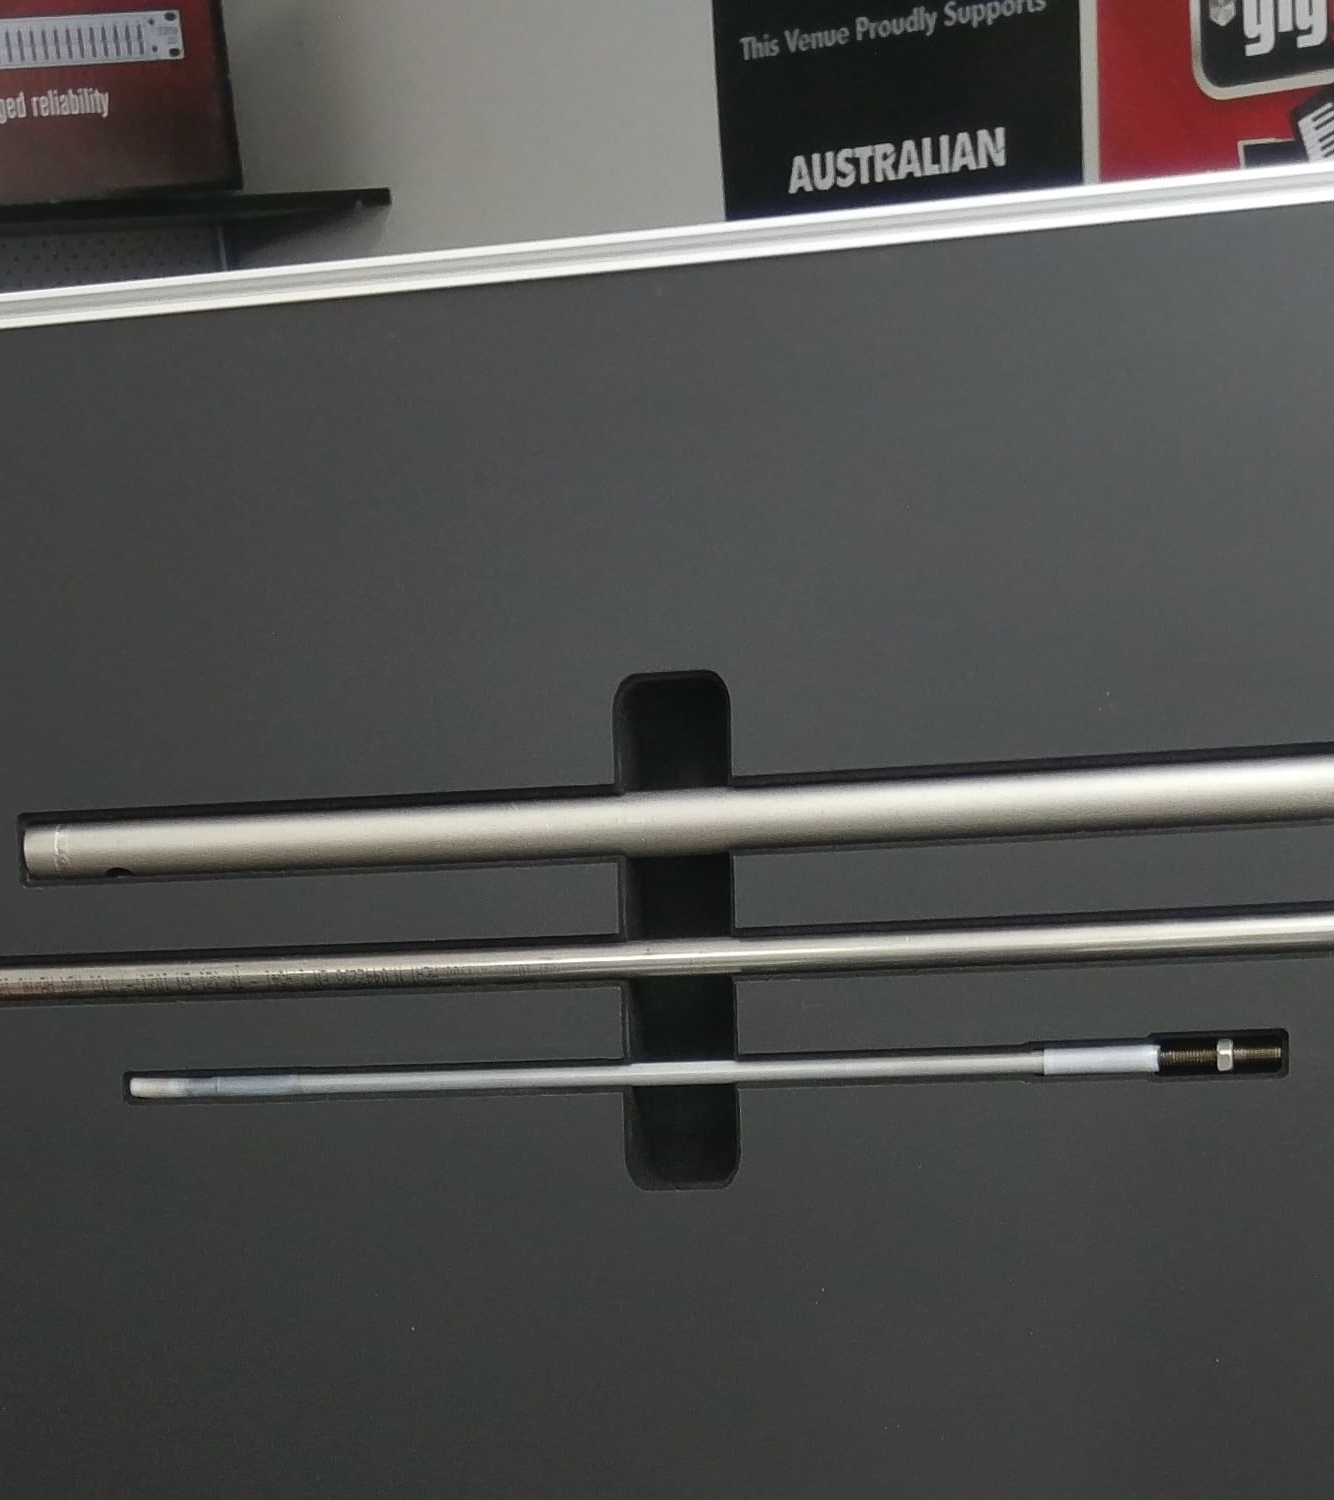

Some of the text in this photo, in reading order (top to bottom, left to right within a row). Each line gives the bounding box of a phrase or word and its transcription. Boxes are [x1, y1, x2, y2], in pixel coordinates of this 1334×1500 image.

[740, 34, 779, 60] This
[785, 26, 850, 53] Venue
[855, 6, 938, 40] Proudly
[31, 87, 110, 118] reliability
[788, 126, 1007, 194] AUSTRALIAN
